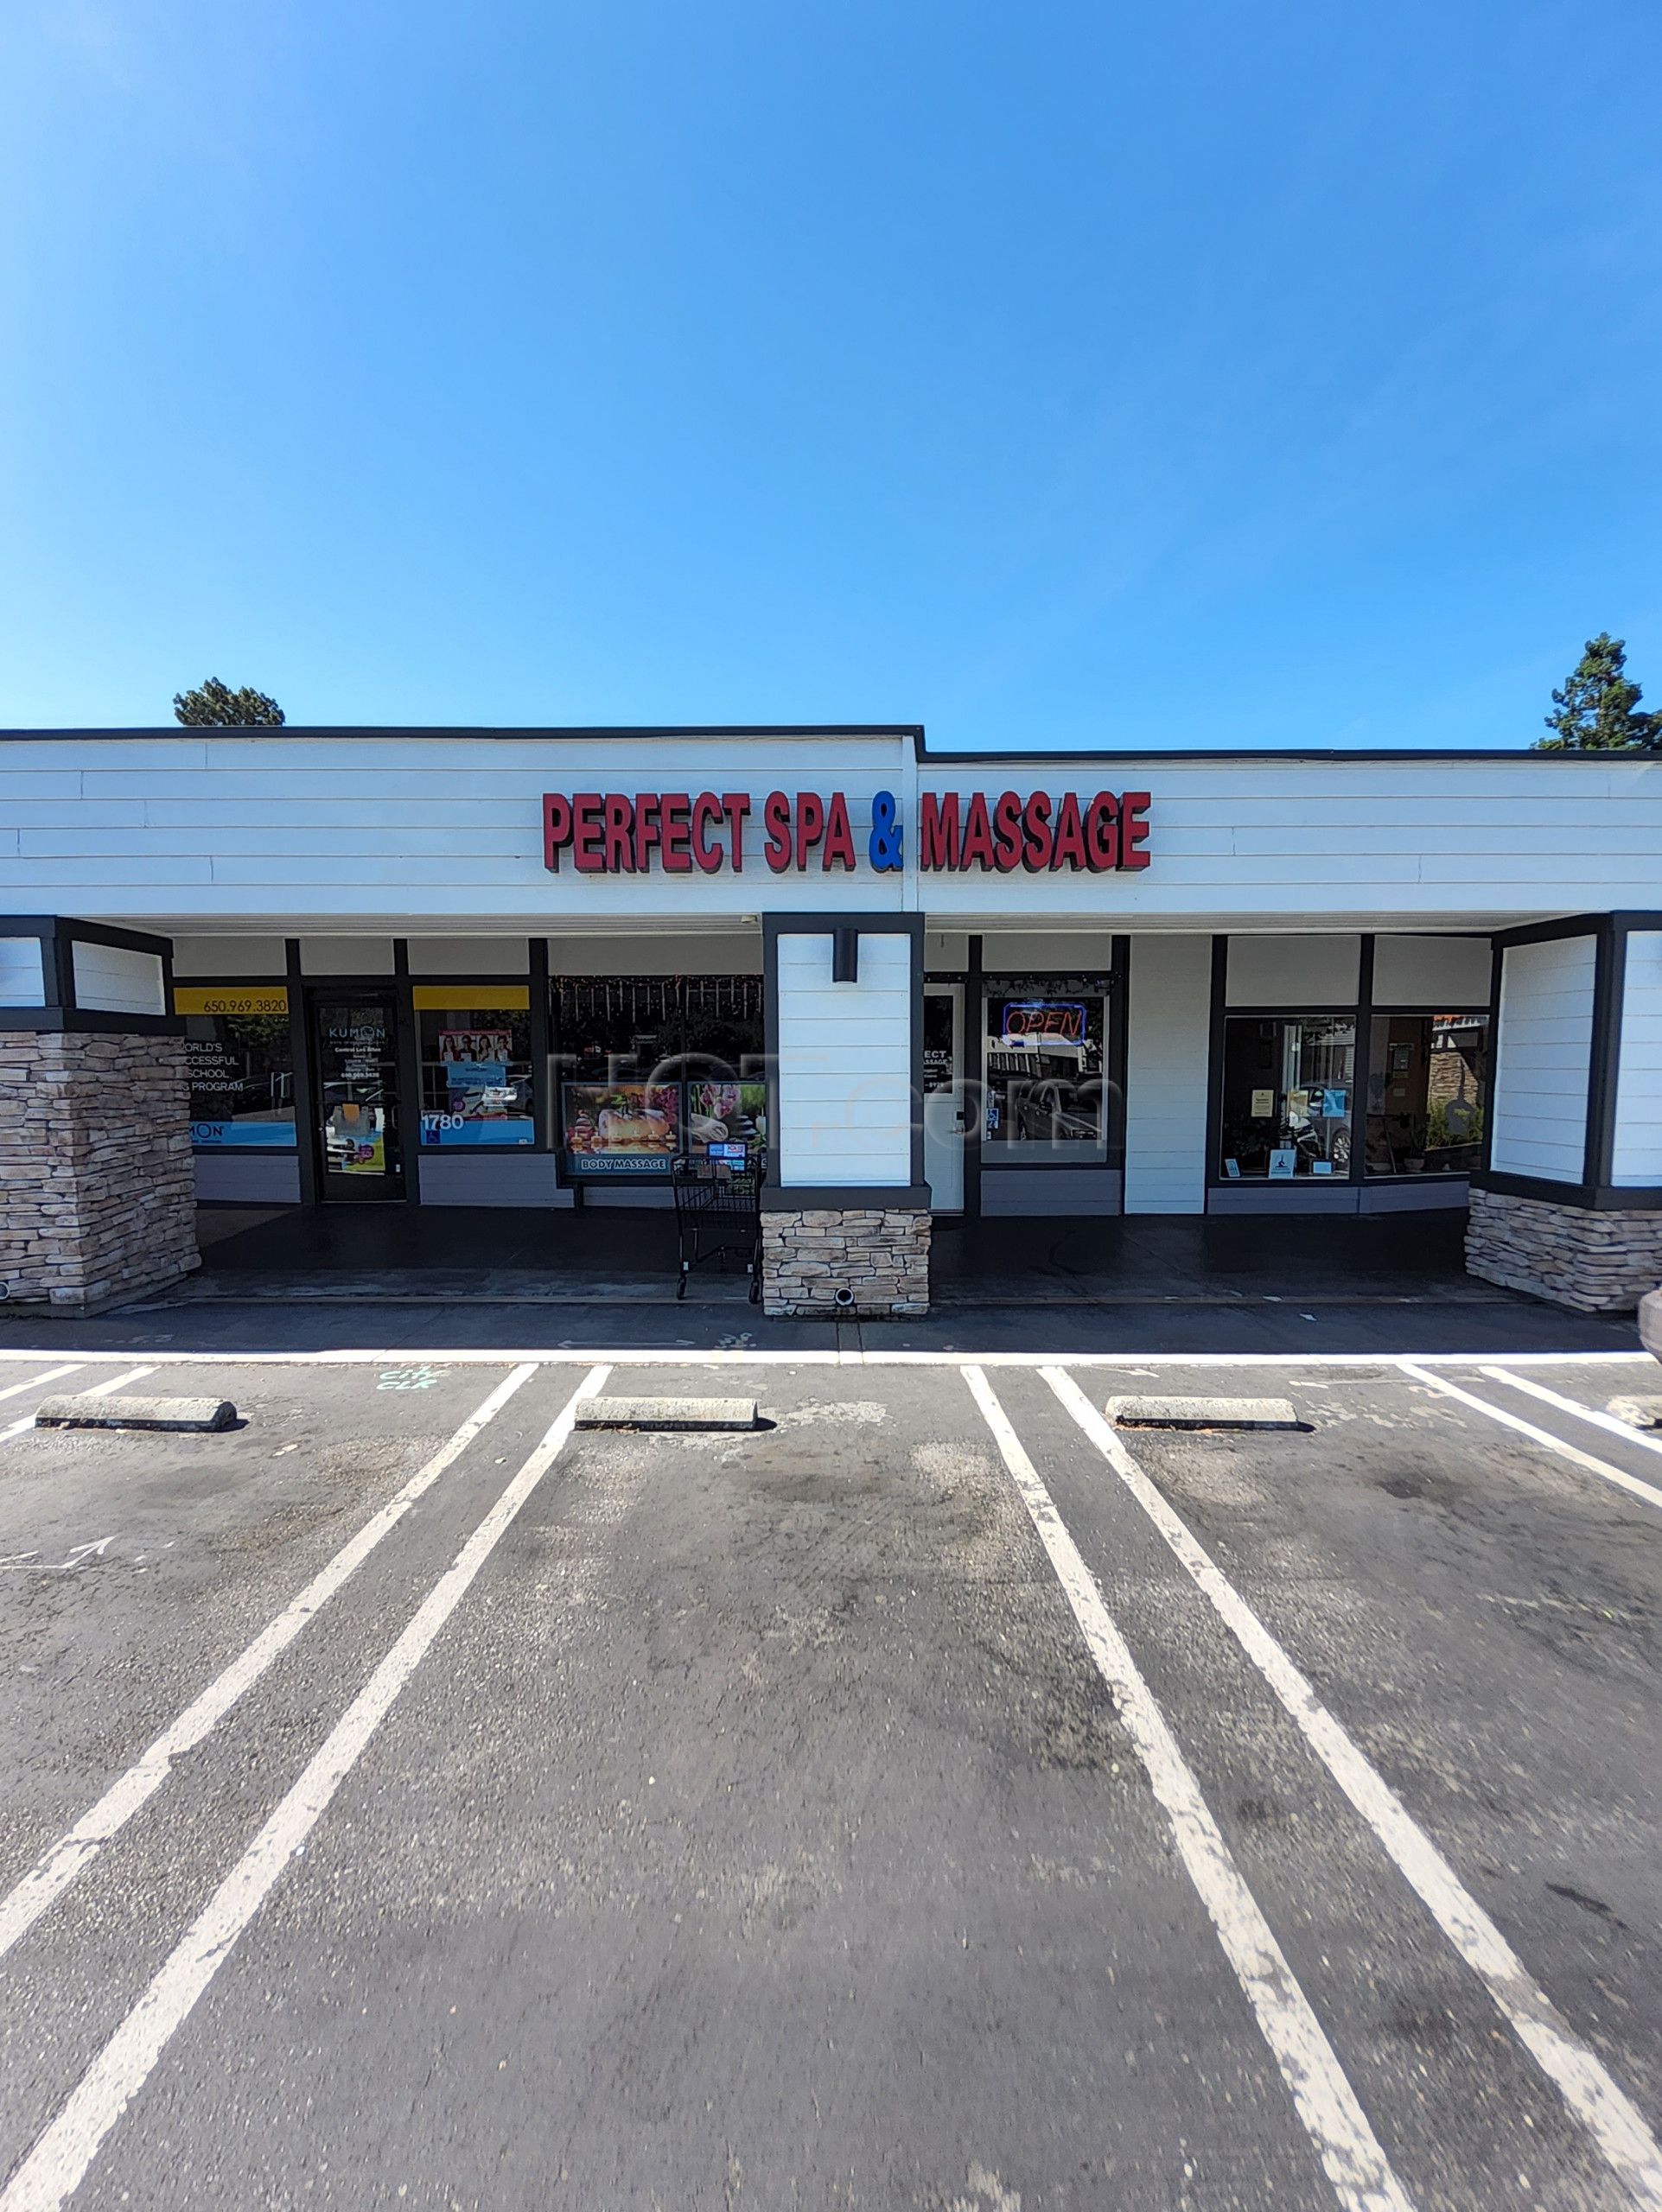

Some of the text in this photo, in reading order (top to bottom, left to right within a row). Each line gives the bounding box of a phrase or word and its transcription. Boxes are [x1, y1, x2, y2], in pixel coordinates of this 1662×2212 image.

[543, 791, 1151, 873] PERFECT SPA & MASSAGE
[203, 1000, 287, 1013] 650.969.3820
[1006, 1010, 1082, 1037] OPEN
[328, 1026, 385, 1040] KUMON
[182, 1043, 223, 1052] ORLD'S
[192, 1082, 244, 1091] PROGRAM
[422, 1115, 464, 1131] 1780
[581, 1159, 665, 1170] BODY MASSAGE
